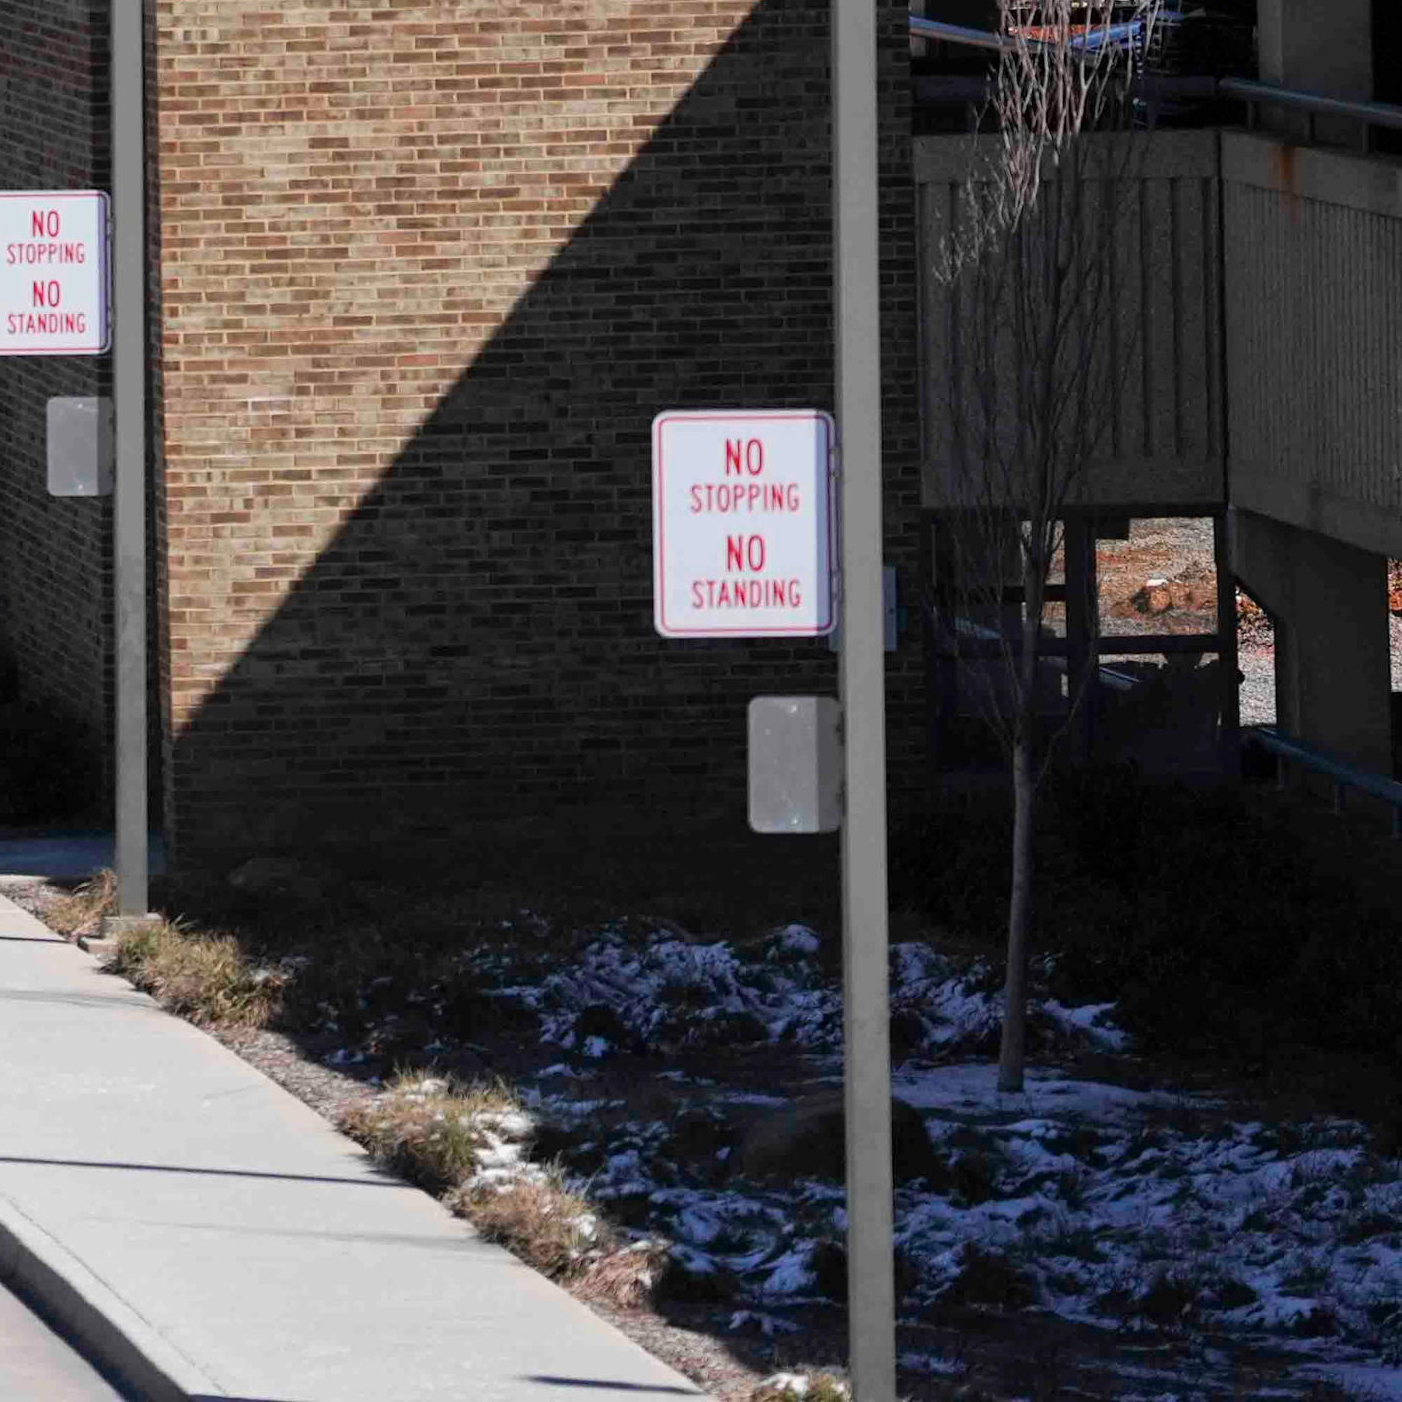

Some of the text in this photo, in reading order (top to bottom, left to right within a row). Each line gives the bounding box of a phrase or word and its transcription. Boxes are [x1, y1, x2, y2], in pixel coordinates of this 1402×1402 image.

[31, 210, 60, 237] NO
[6, 242, 86, 265] STOPPING
[32, 280, 60, 308] NO
[7, 312, 87, 335] STANDING
[724, 438, 764, 477] NO
[690, 483, 801, 514] STOPPING
[725, 534, 766, 573] NO
[691, 579, 802, 610] STANDING
